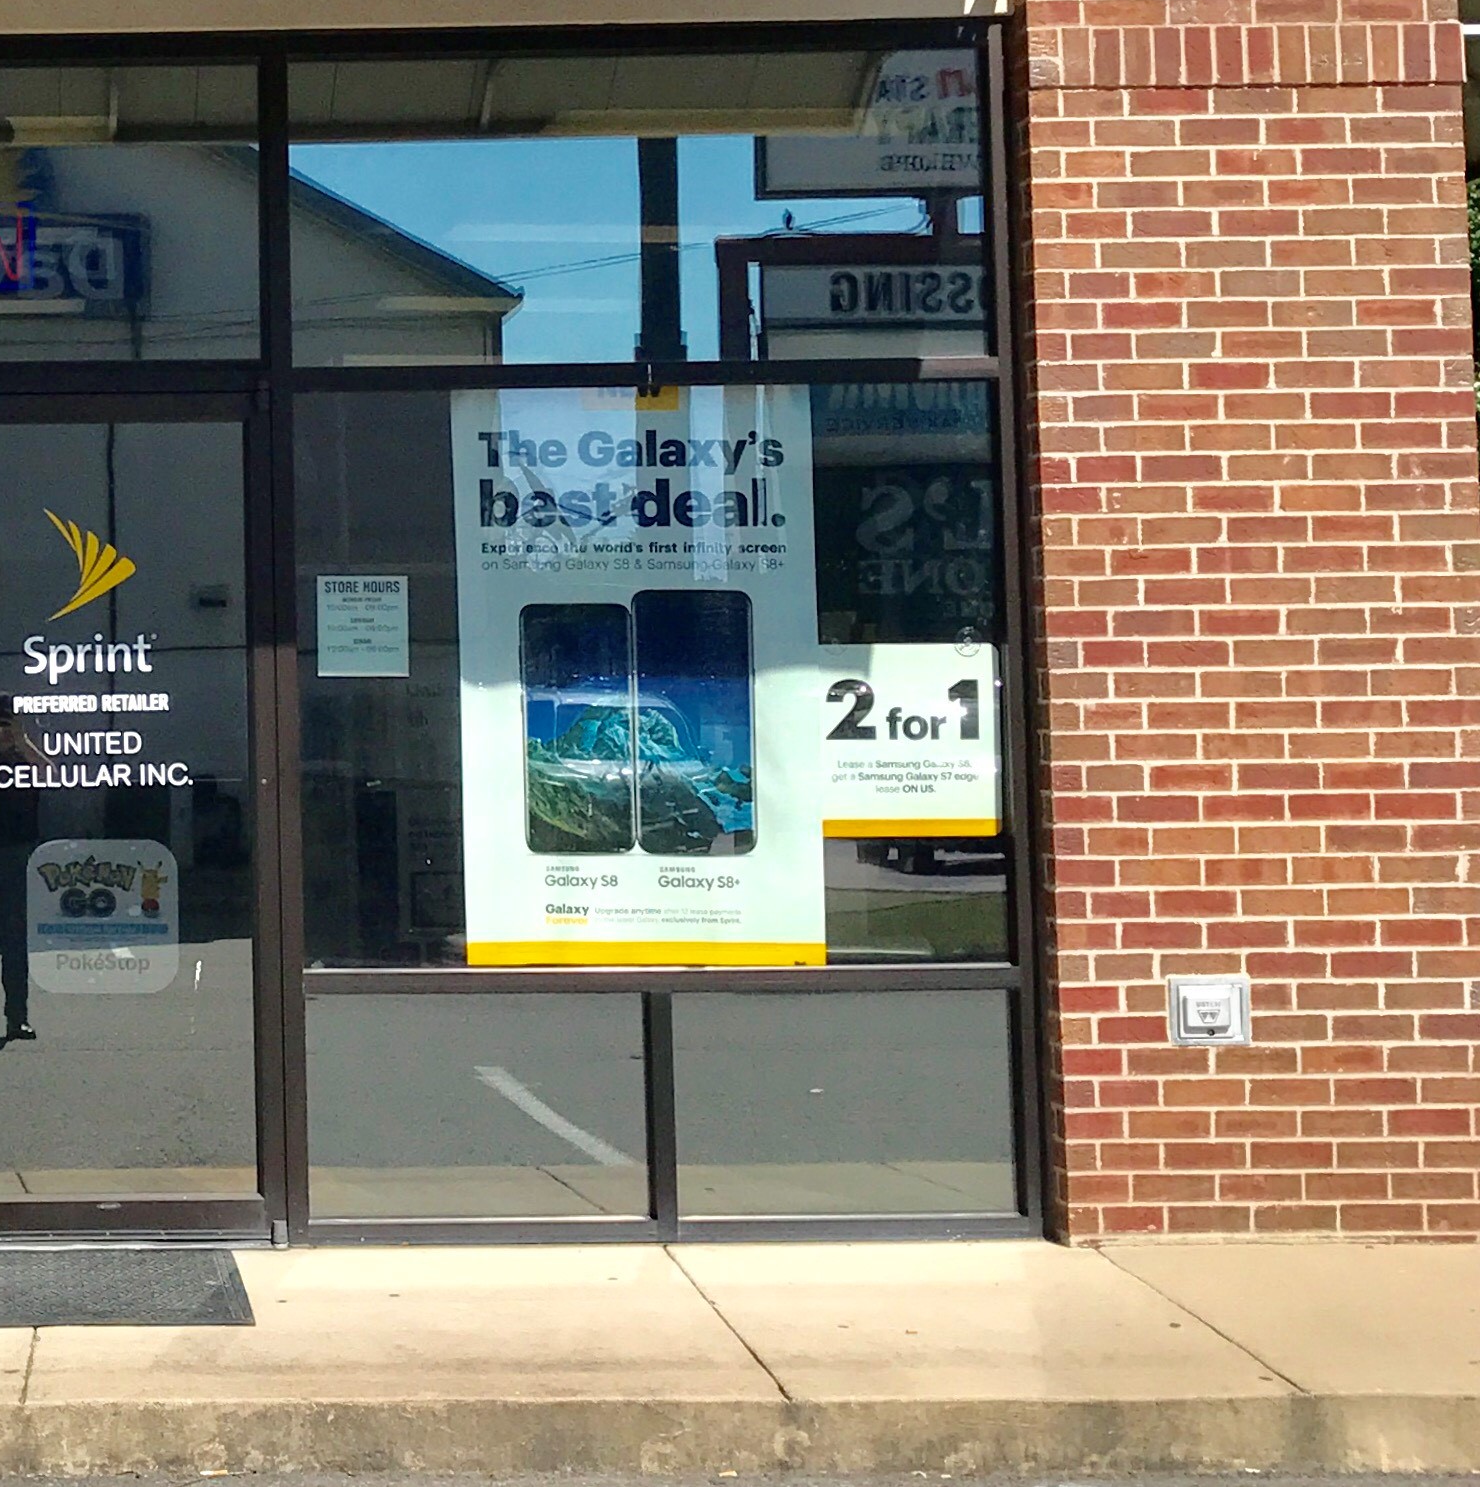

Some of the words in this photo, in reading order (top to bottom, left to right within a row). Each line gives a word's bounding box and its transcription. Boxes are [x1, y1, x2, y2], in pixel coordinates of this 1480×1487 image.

[478, 429, 566, 468] The
[479, 478, 617, 528] best
[631, 477, 786, 528] deal.
[648, 541, 677, 553] first
[683, 542, 732, 555] infinity
[737, 542, 786, 554] screen
[482, 560, 498, 570] on
[565, 558, 609, 572] Galaxy
[613, 558, 630, 570] S8
[633, 558, 642, 570] &
[710, 558, 755, 572] Galaxy
[324, 581, 359, 593] STORE
[363, 581, 400, 593] HOURS
[23, 633, 153, 685] Sprint
[13, 694, 97, 714] PREFERRED
[101, 693, 170, 712] RETAILER
[825, 679, 877, 740] 2
[885, 707, 947, 740] for
[947, 679, 980, 740] 1
[44, 731, 143, 756] UNITED
[837, 760, 865, 769] Lease
[875, 760, 921, 770] Samsung
[139, 762, 194, 787] INC.
[858, 772, 904, 782] Samsung
[906, 772, 938, 782] Galaxy
[940, 772, 952, 780] S7
[954, 773, 979, 782] edge
[875, 785, 900, 793] lease
[902, 785, 918, 793] ON
[920, 785, 936, 793] US.
[545, 874, 597, 890] Galaxy
[600, 874, 619, 887] S8
[658, 875, 714, 891] Galaxy
[717, 876, 741, 888] S8+
[60, 888, 117, 918] GO
[545, 903, 589, 916] Galaxy
[56, 953, 151, 974] PokéStop
